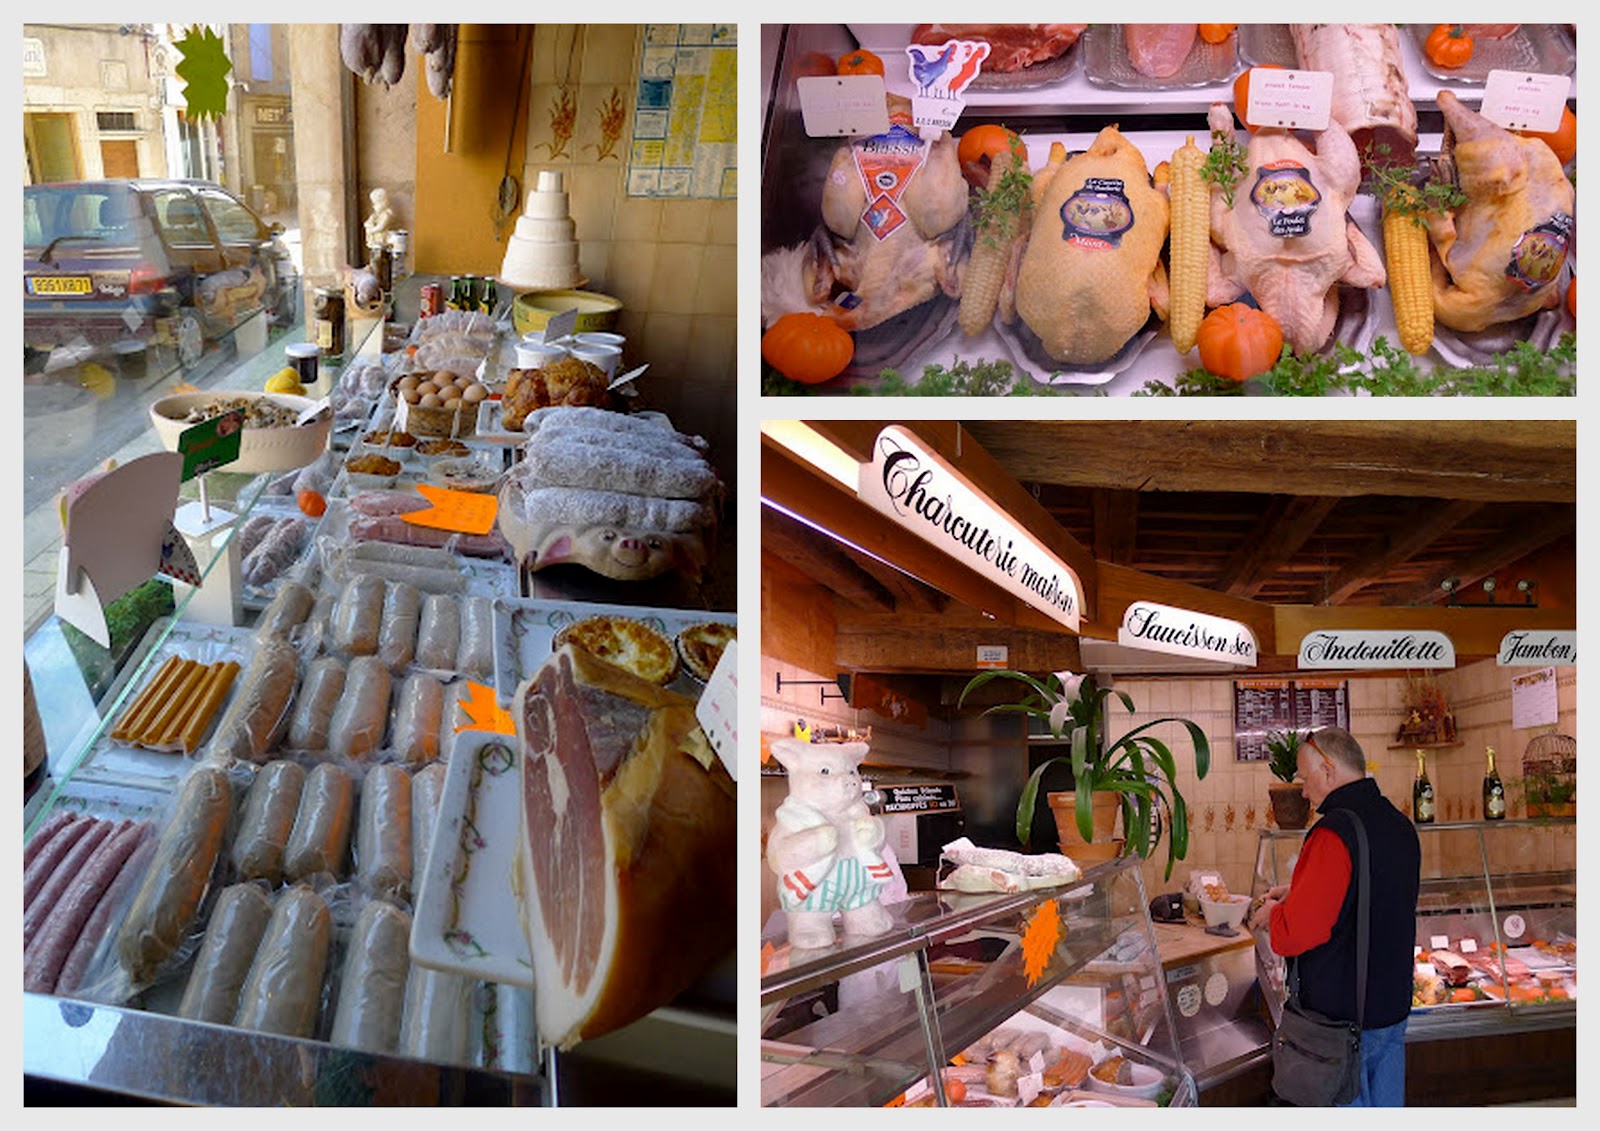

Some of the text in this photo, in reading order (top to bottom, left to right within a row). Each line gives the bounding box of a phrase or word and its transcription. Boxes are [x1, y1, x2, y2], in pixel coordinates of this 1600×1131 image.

[879, 436, 1075, 615] Charcuterie maison
[1127, 607, 1253, 656] Saucisson sec
[1303, 634, 1447, 665] Andouillette
[1503, 632, 1571, 664] Jambon
